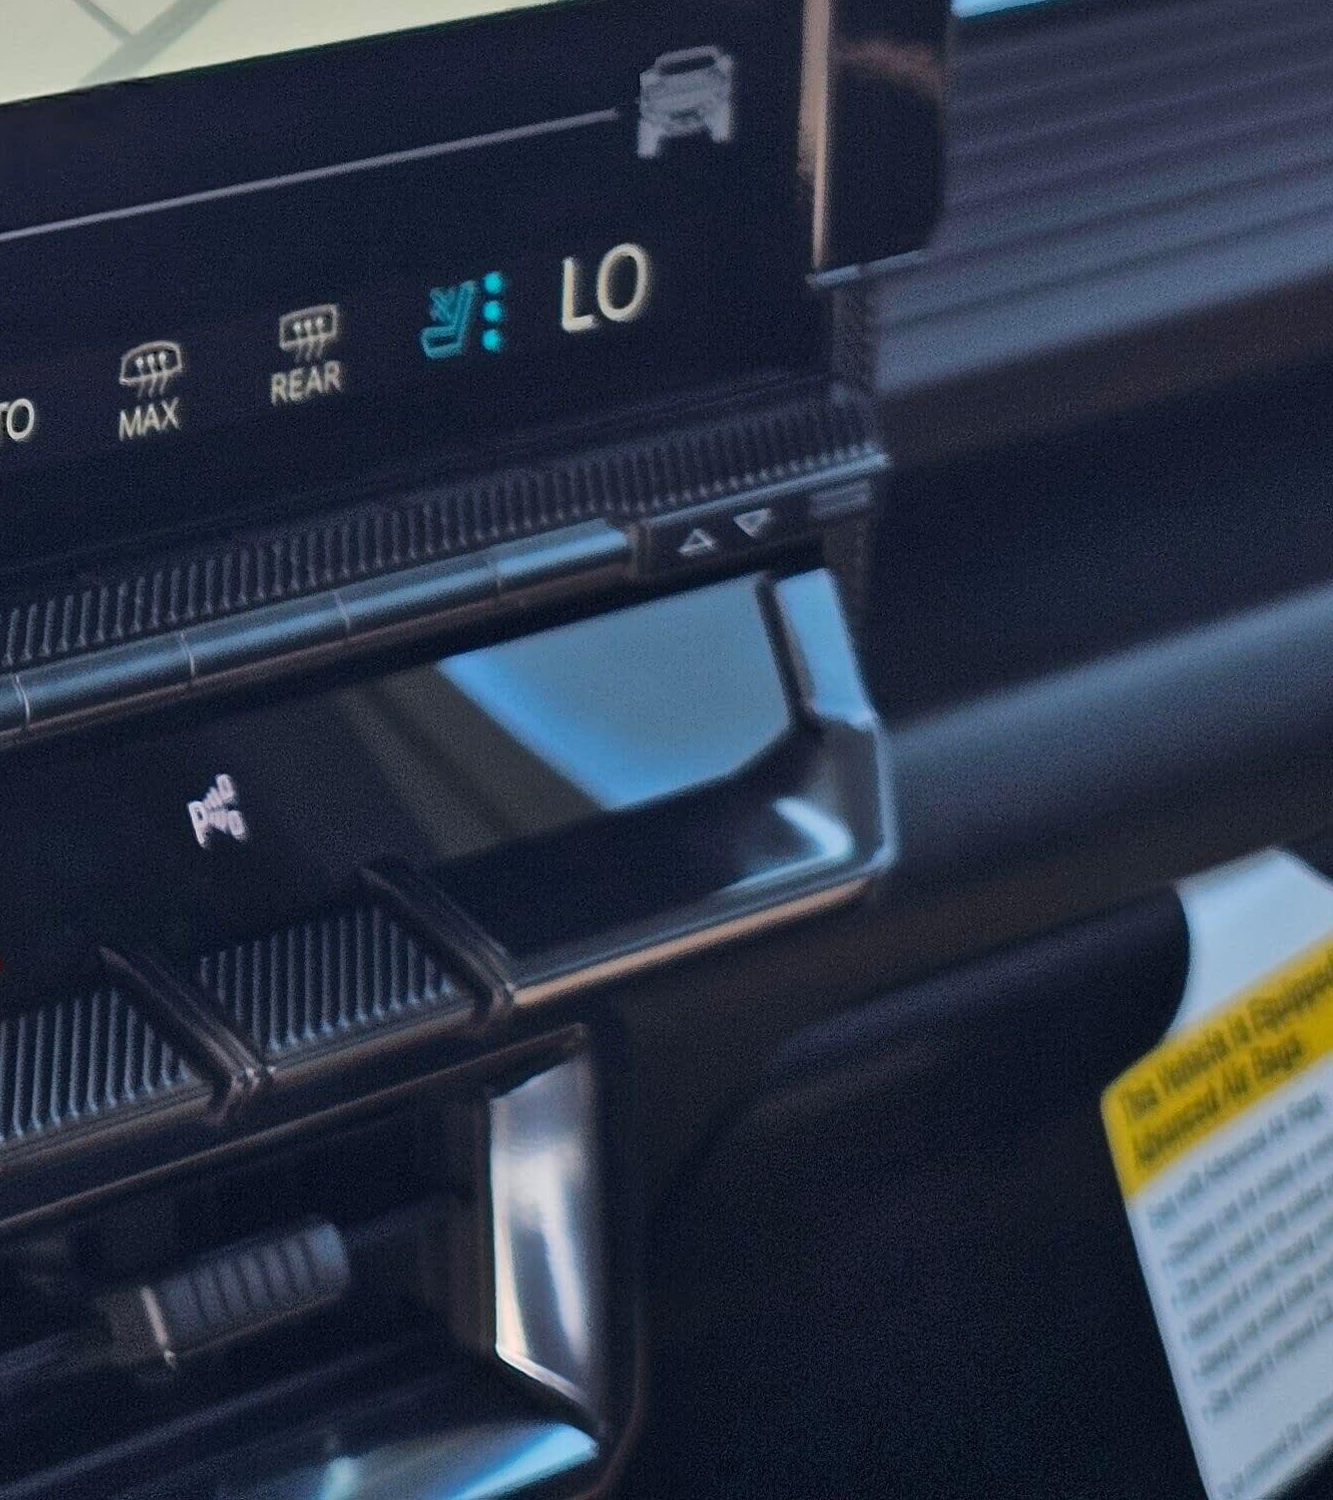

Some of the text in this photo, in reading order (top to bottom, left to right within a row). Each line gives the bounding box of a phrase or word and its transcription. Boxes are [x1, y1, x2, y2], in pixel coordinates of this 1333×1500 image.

[559, 243, 651, 332] LO
[270, 360, 343, 406] REAR
[118, 398, 182, 441] MAX
